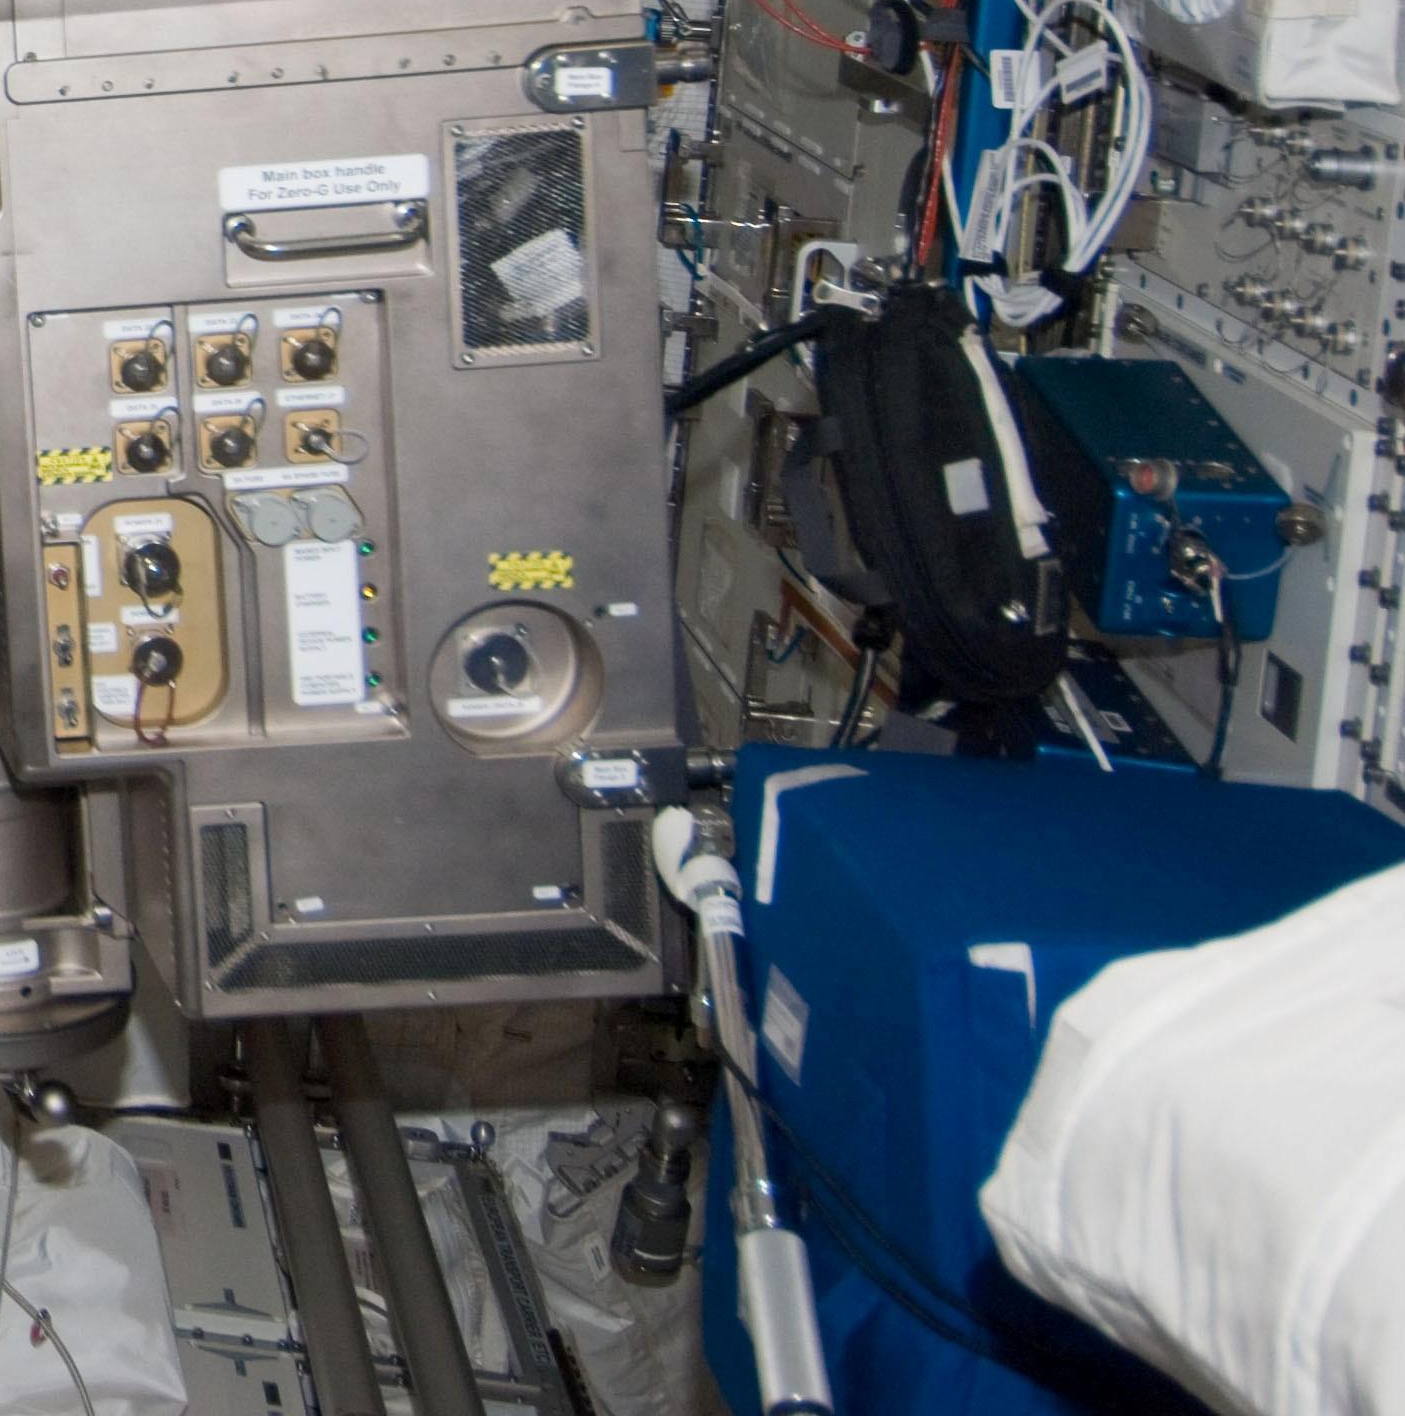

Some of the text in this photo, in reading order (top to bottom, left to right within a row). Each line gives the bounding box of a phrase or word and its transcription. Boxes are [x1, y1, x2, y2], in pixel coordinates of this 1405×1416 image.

[261, 162, 387, 183] Main box handle
[247, 179, 402, 201] For Zero-G Use Only
[482, 1195, 509, 1244] EUROPEAN
[498, 1243, 526, 1295] TRANSPORT
[515, 1294, 544, 1341] CARRIER
